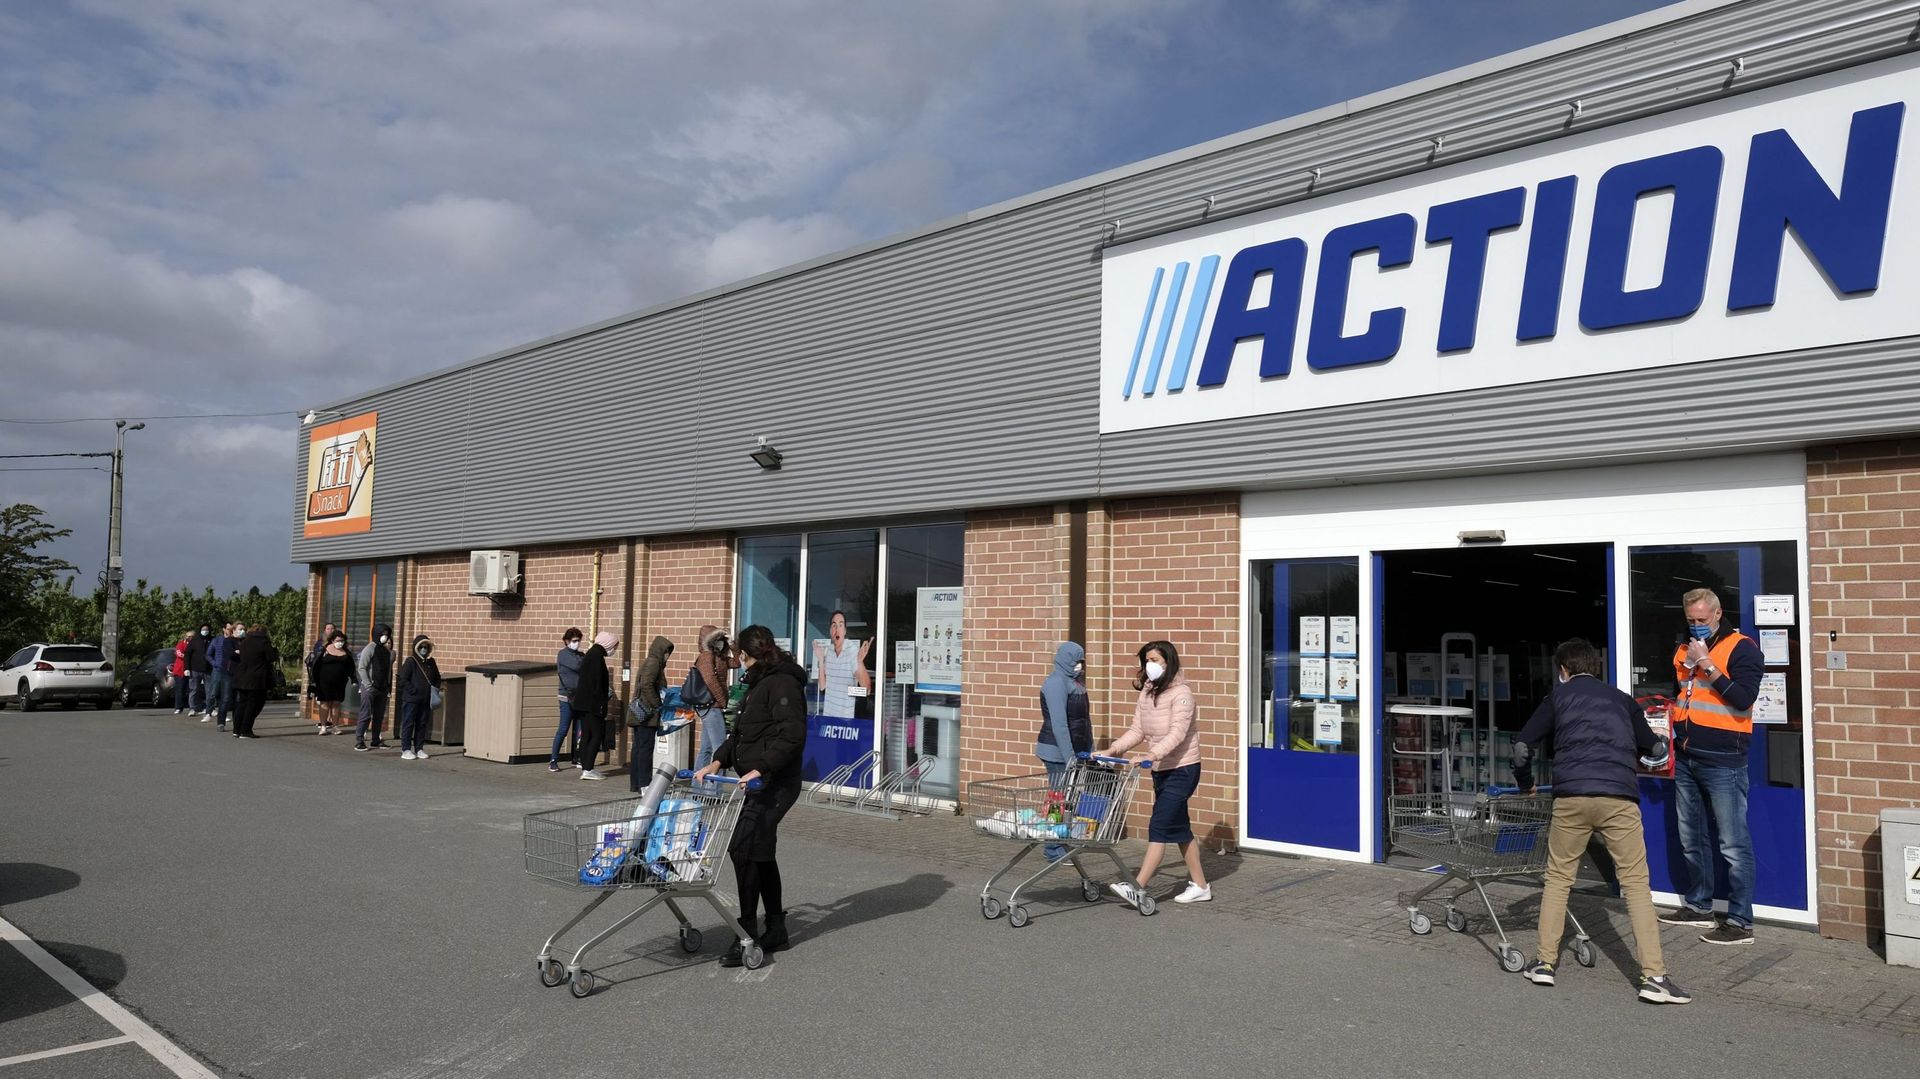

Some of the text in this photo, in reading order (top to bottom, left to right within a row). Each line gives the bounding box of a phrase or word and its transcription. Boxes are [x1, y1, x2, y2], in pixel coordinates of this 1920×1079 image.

[1197, 101, 1906, 387] ACTION
[313, 491, 344, 514] Snack
[934, 593, 958, 602] ACTION
[824, 725, 860, 741] ACTION
